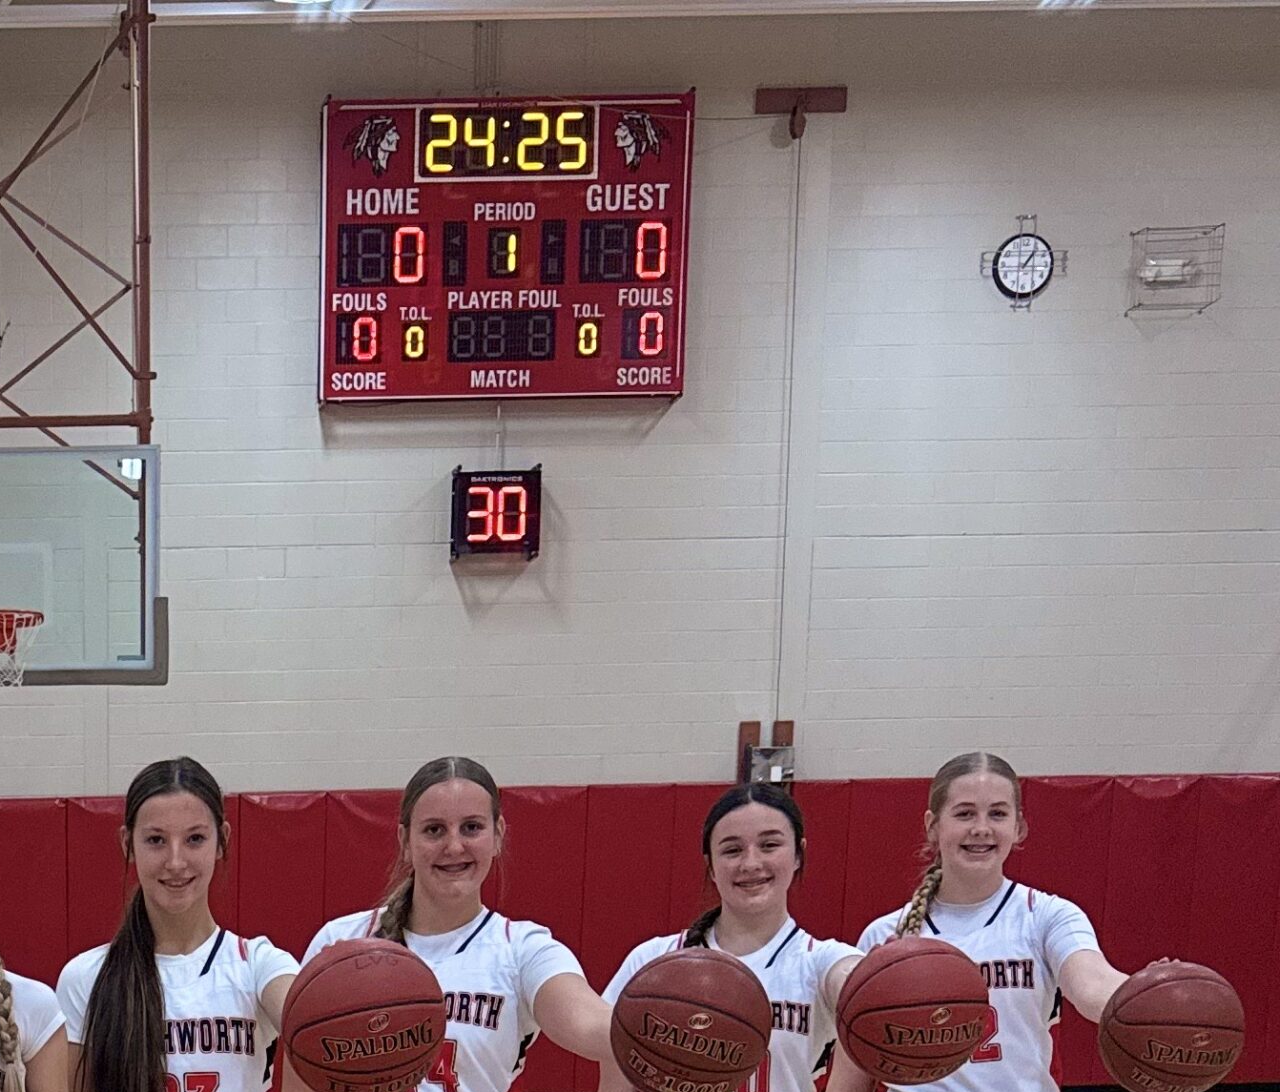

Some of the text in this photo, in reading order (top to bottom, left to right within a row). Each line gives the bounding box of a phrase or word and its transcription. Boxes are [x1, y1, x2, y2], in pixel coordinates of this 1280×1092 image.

[425, 112, 587, 172] 24:25
[346, 188, 419, 215] HOME
[473, 203, 536, 221] PERIOD
[586, 184, 670, 211] GUEST
[393, 227, 425, 283] 0
[507, 234, 517, 272] 1
[636, 222, 667, 279] 0
[332, 293, 387, 312] FOULS
[447, 290, 562, 310] PLAYER FOUL
[572, 304, 605, 318] T.O.L.
[618, 288, 673, 307] FOULS
[399, 306, 432, 321] T.O.L.
[352, 316, 377, 360] 0
[405, 326, 424, 358] 0
[578, 322, 597, 355] 0
[638, 311, 663, 355] 0
[331, 372, 387, 390] SCORE
[470, 370, 530, 388] MATCH
[616, 367, 672, 385] SCORE
[467, 486, 527, 541] 30
[321, 1016, 433, 1064] SPALDING
[638, 1011, 747, 1067] SPALDING
